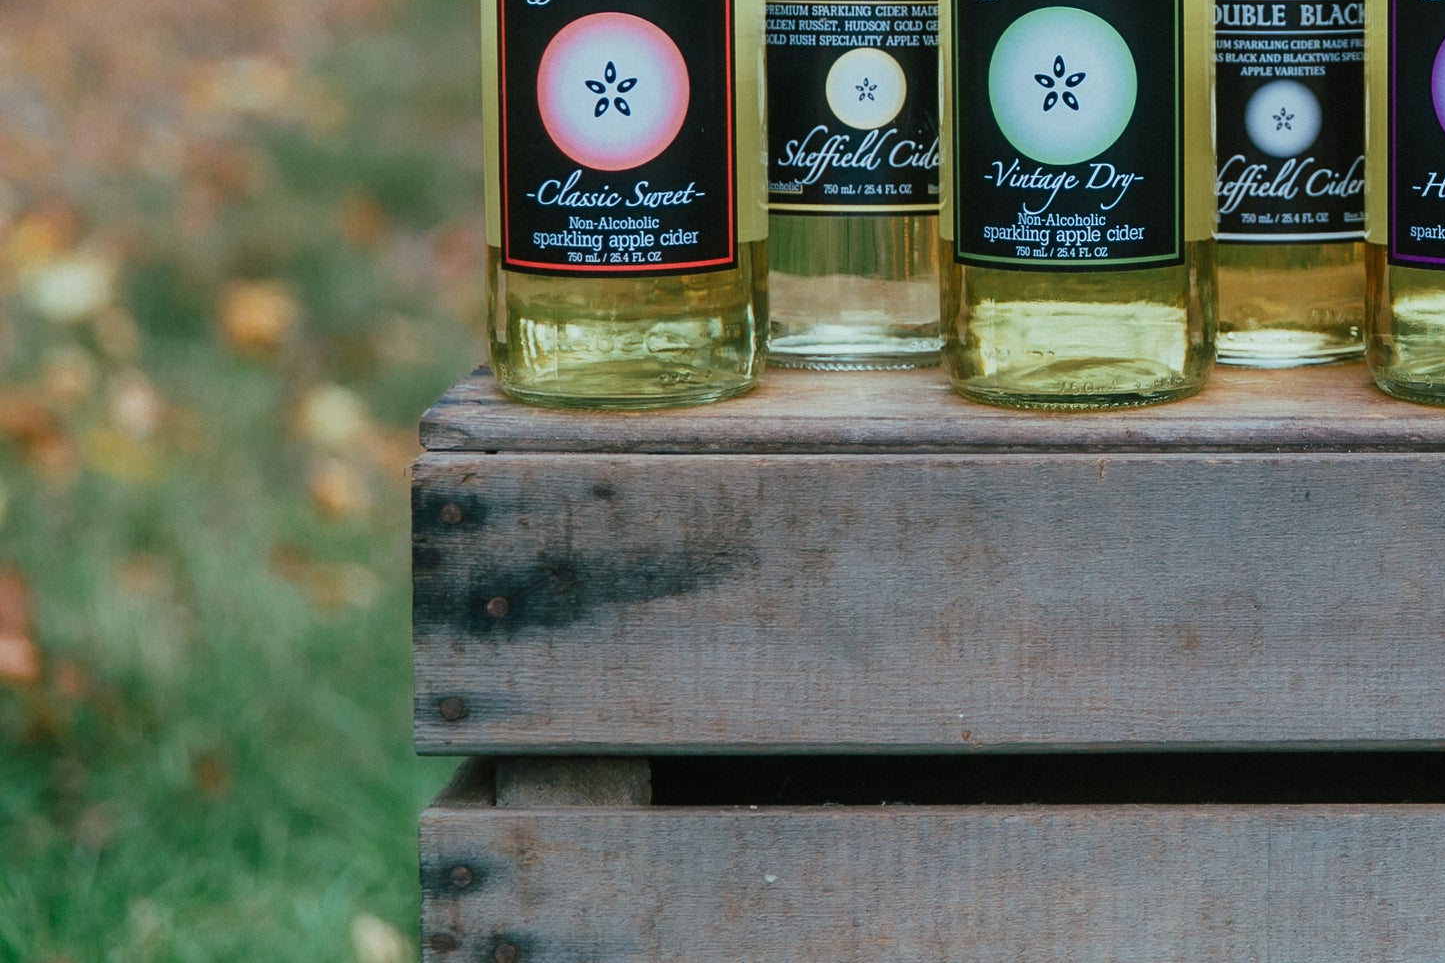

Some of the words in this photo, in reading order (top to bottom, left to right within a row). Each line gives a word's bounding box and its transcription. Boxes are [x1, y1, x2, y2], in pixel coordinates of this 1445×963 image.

[812, 5, 872, 16] SPARKLING
[875, 6, 908, 16] CIDER
[799, 20, 840, 32] RUSSET,
[844, 20, 890, 32] HUDSON
[894, 20, 923, 32] GOLD
[789, 35, 816, 46] RUSH
[886, 36, 920, 46] APPLE
[1233, 40, 1289, 50] SPARKLING
[1290, 40, 1321, 50] CIDER
[1322, 38, 1348, 49] MADE
[1225, 52, 1258, 63] BLACK
[1259, 52, 1282, 63] AND
[1283, 52, 1340, 63] BLACKTWIG
[1240, 66, 1272, 76] APPLE
[1274, 66, 1326, 76] VARIETIES
[778, 125, 898, 185] Sheffield
[823, 184, 838, 195] 750
[841, 184, 856, 195] mL
[864, 184, 882, 195] 25.4
[884, 184, 897, 195] FL
[899, 184, 912, 195] OZ
[568, 216, 660, 230] Non-Alcoholic
[1018, 212, 1106, 226] Non-Alcoholic
[1241, 212, 1256, 224] 750
[1258, 212, 1273, 224] mL
[1282, 212, 1300, 224] 25.4
[1302, 212, 1314, 224] FL
[1316, 212, 1329, 224] OZ
[533, 230, 603, 251] sparkling
[609, 231, 654, 251] apple
[660, 229, 699, 246] cider
[984, 224, 1050, 245] sparkling
[1056, 227, 1101, 246] apple
[1106, 226, 1144, 242] cider
[568, 252, 582, 262] 750
[586, 252, 600, 262] mL
[610, 252, 629, 262] 25.4
[632, 252, 645, 262] FL
[648, 252, 662, 262] OZ
[1016, 246, 1030, 258] 750
[1033, 246, 1048, 258] mL
[1057, 246, 1076, 258] 25.4
[1079, 246, 1092, 258] FL
[1094, 246, 1108, 258] OZ
